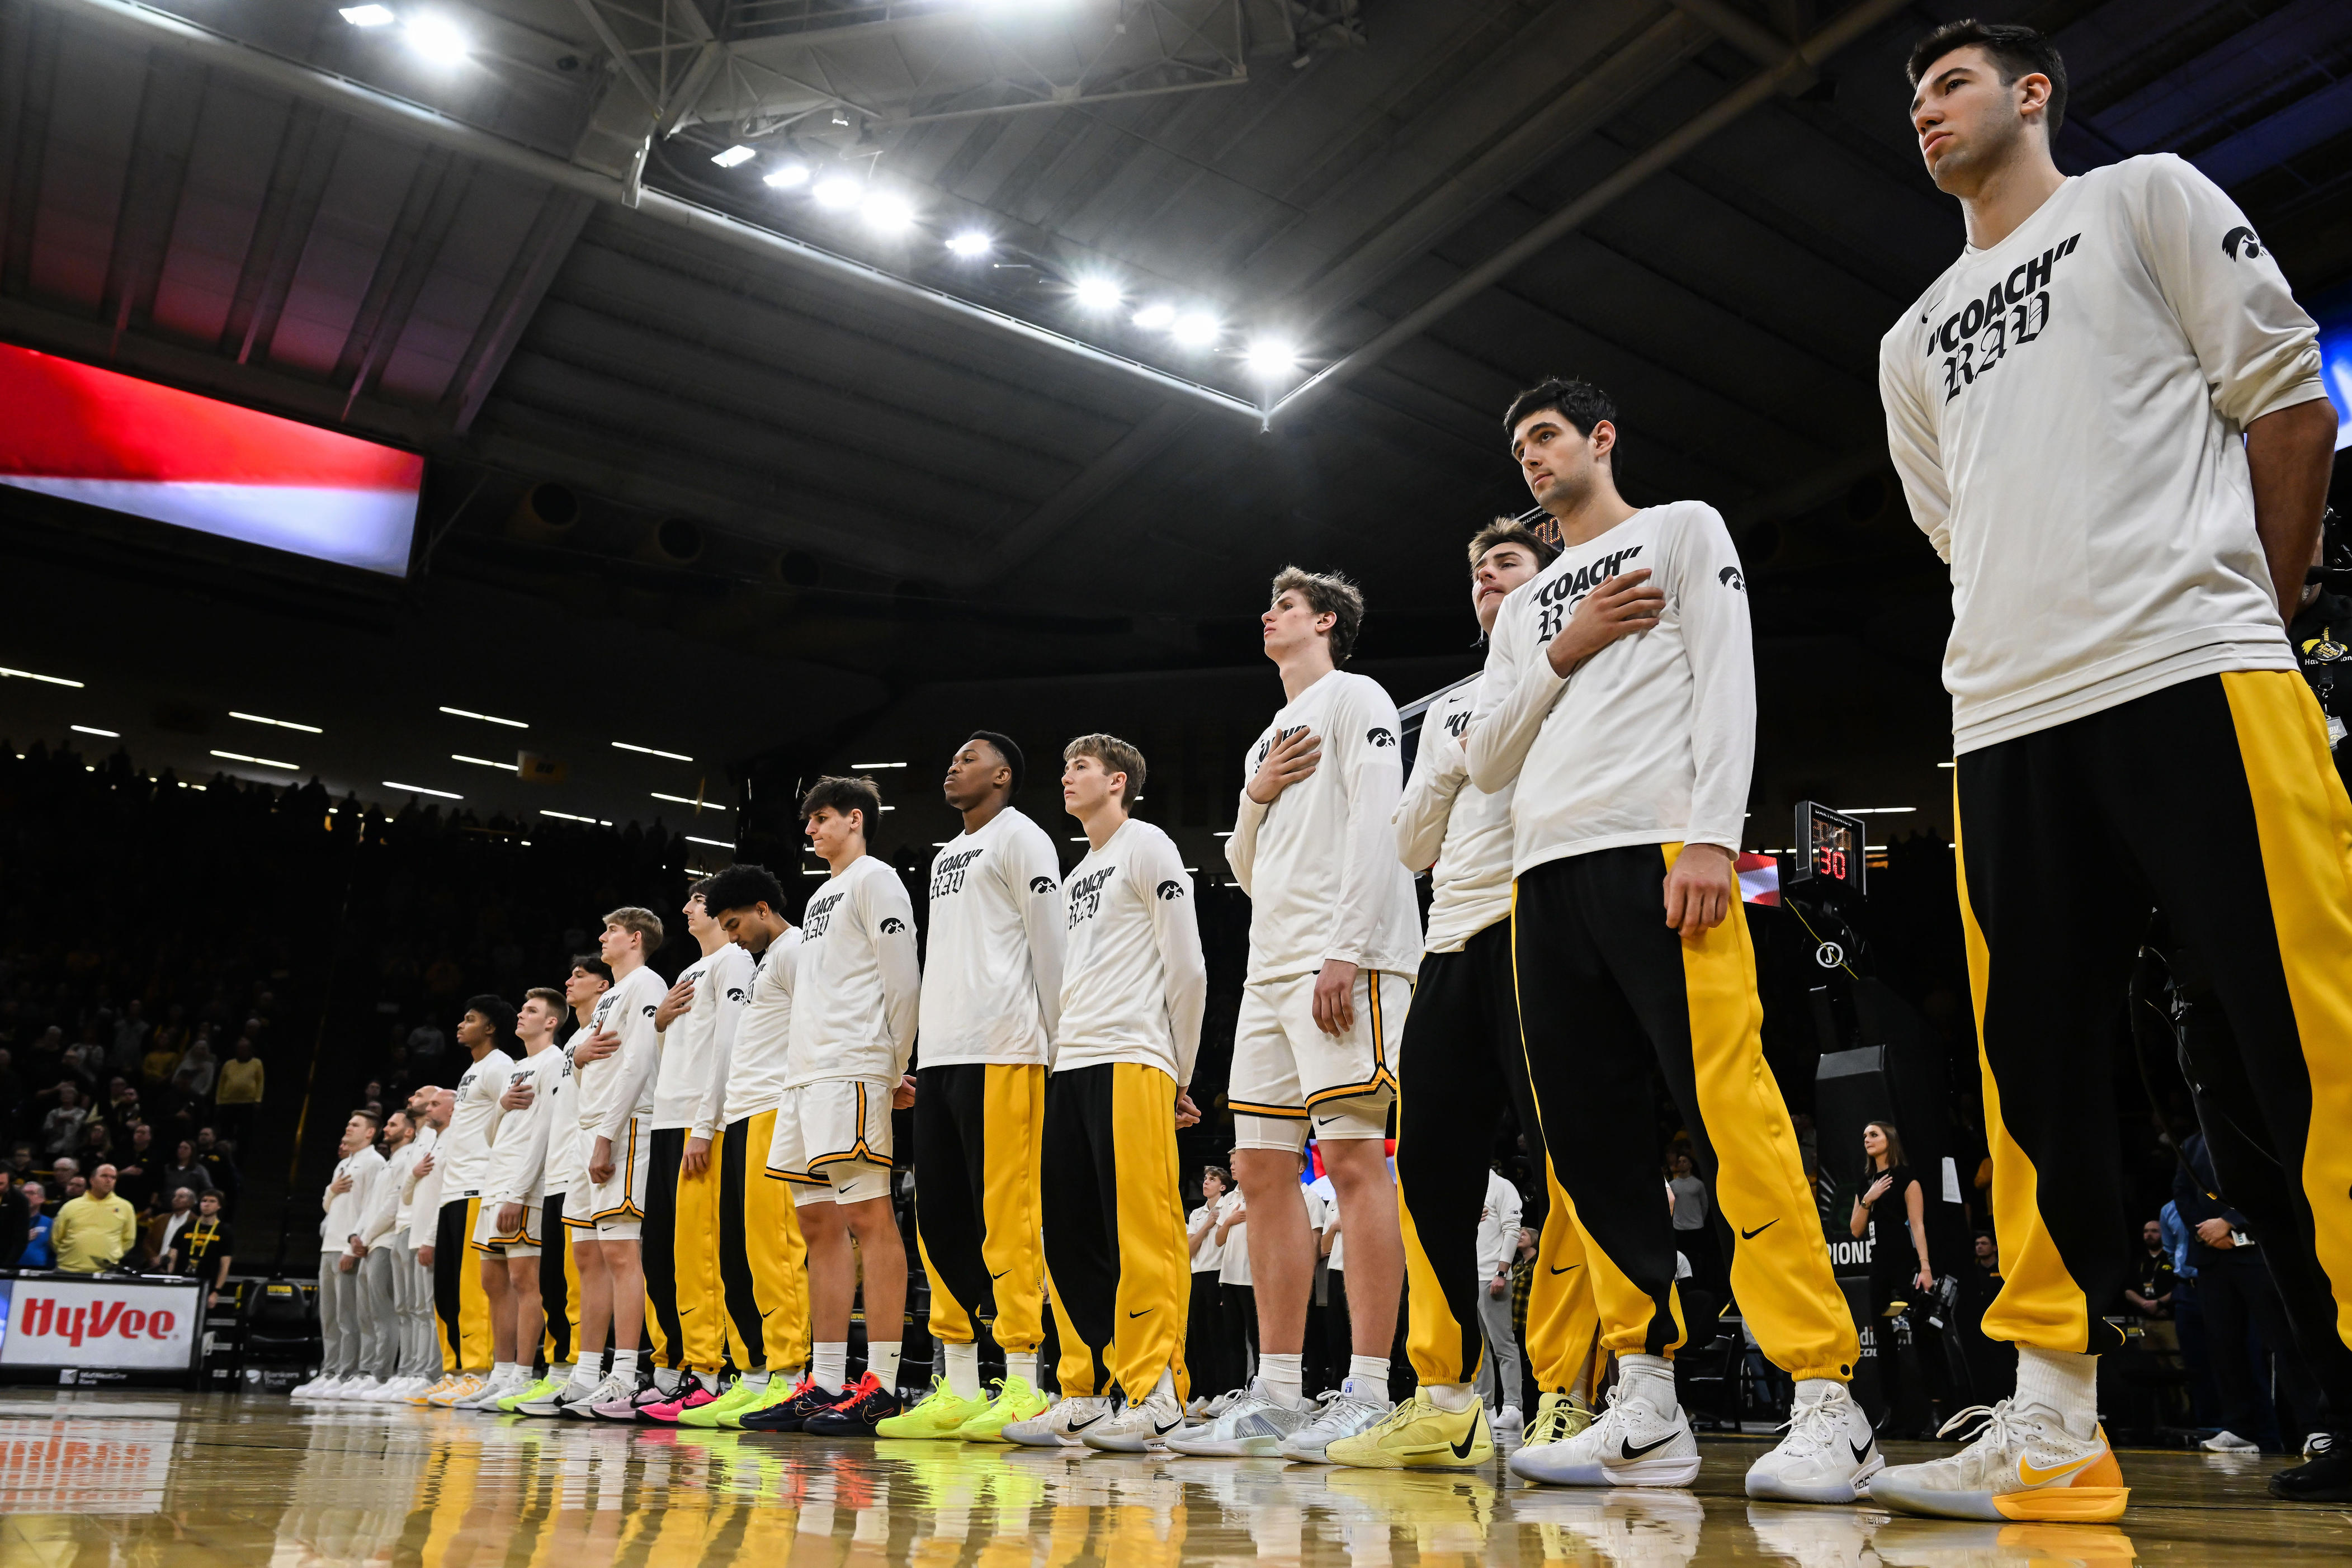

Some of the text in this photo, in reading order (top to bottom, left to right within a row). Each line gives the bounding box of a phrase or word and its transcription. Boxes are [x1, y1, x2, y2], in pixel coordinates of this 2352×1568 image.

[1927, 233, 2081, 357] "COACH"
[1528, 545, 1643, 607] "COACH"
[937, 849, 984, 875] "COACH"
[1821, 846, 1845, 880] 30
[1069, 866, 1116, 902] "COACH"
